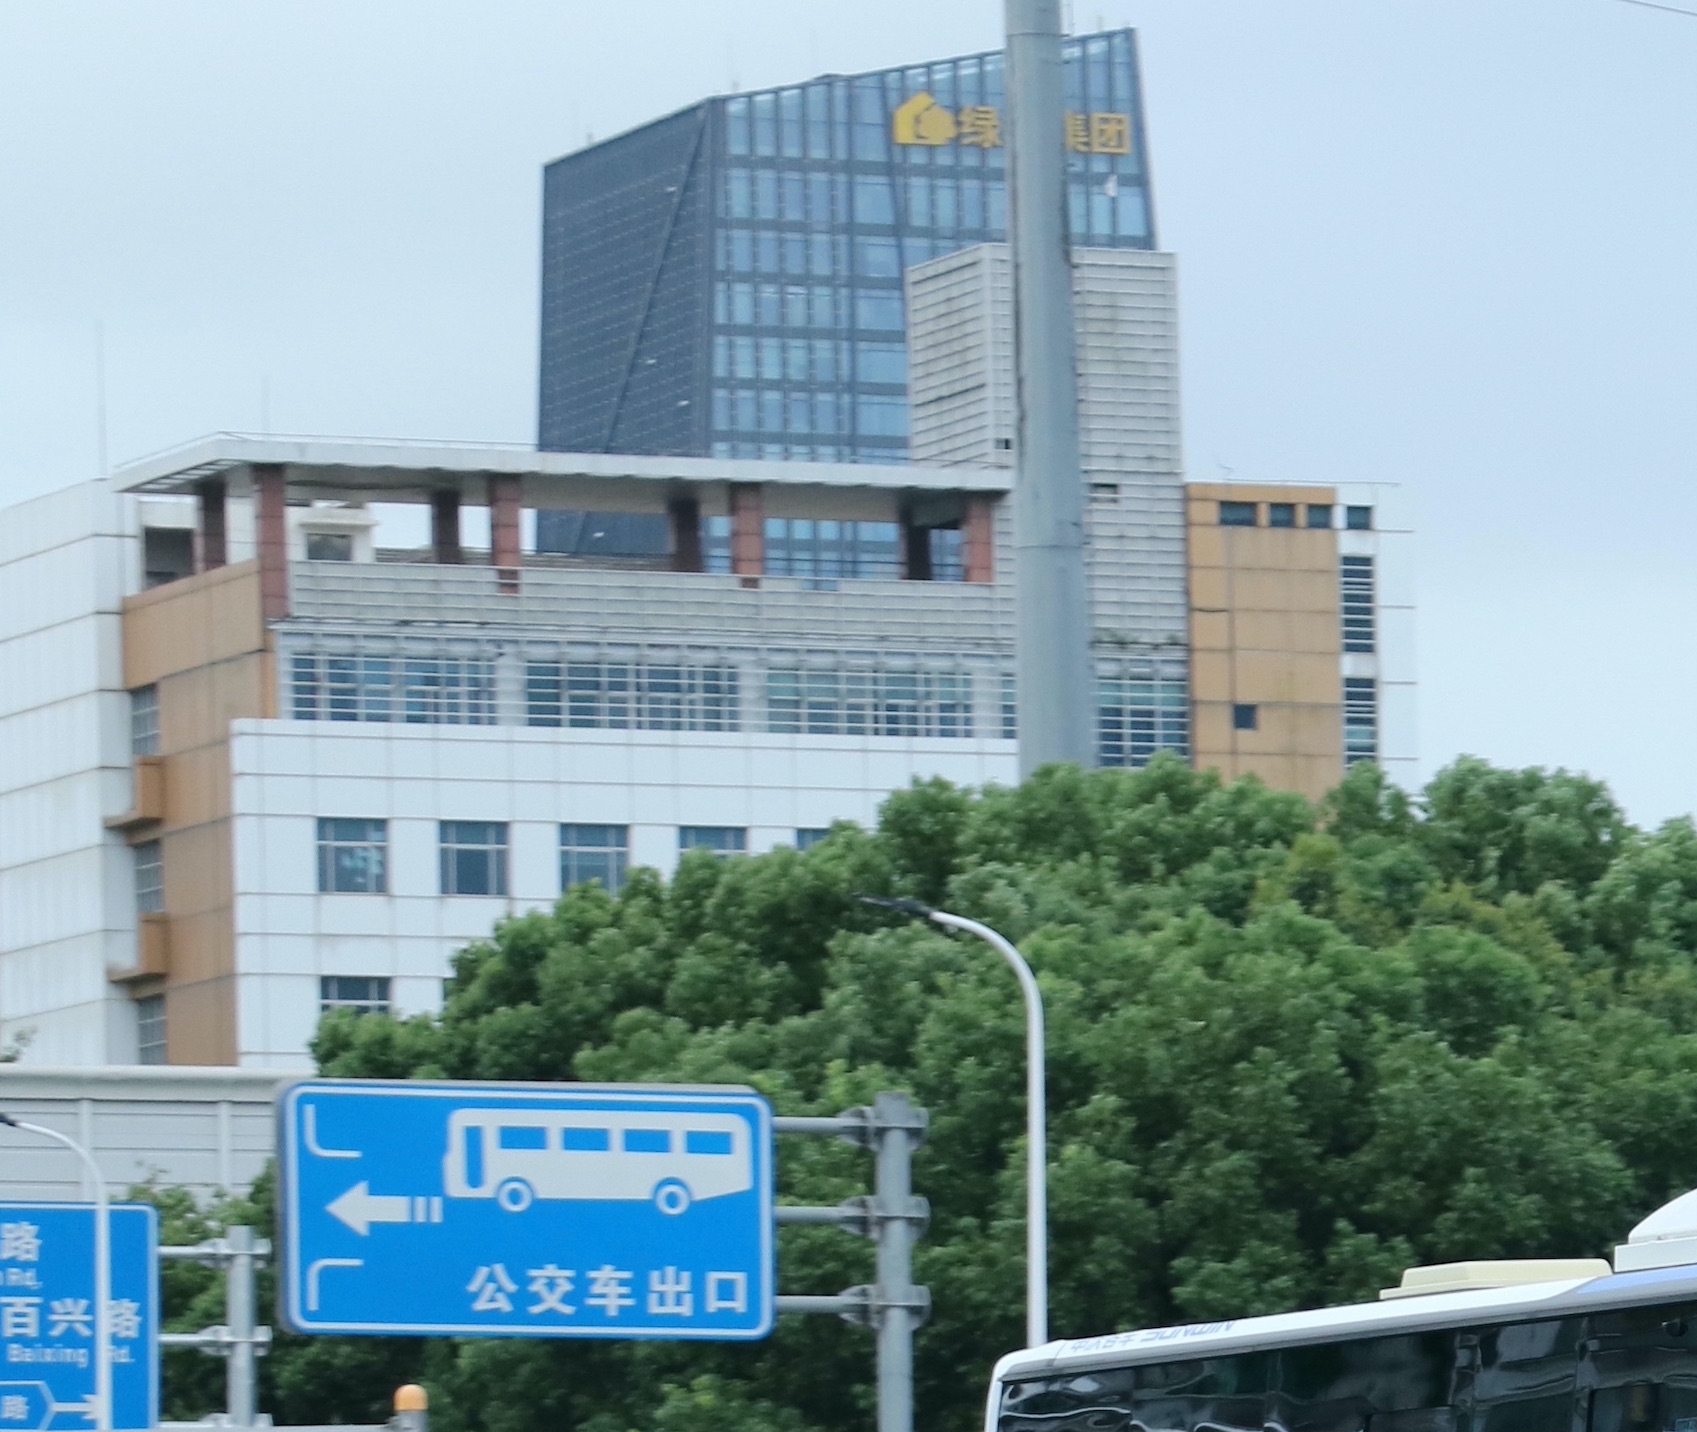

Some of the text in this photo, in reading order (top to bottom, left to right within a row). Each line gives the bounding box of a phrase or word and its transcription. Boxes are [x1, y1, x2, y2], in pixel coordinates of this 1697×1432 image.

[466, 1263, 748, 1316] 公交车出口
[0, 1297, 142, 1338] 百兴路
